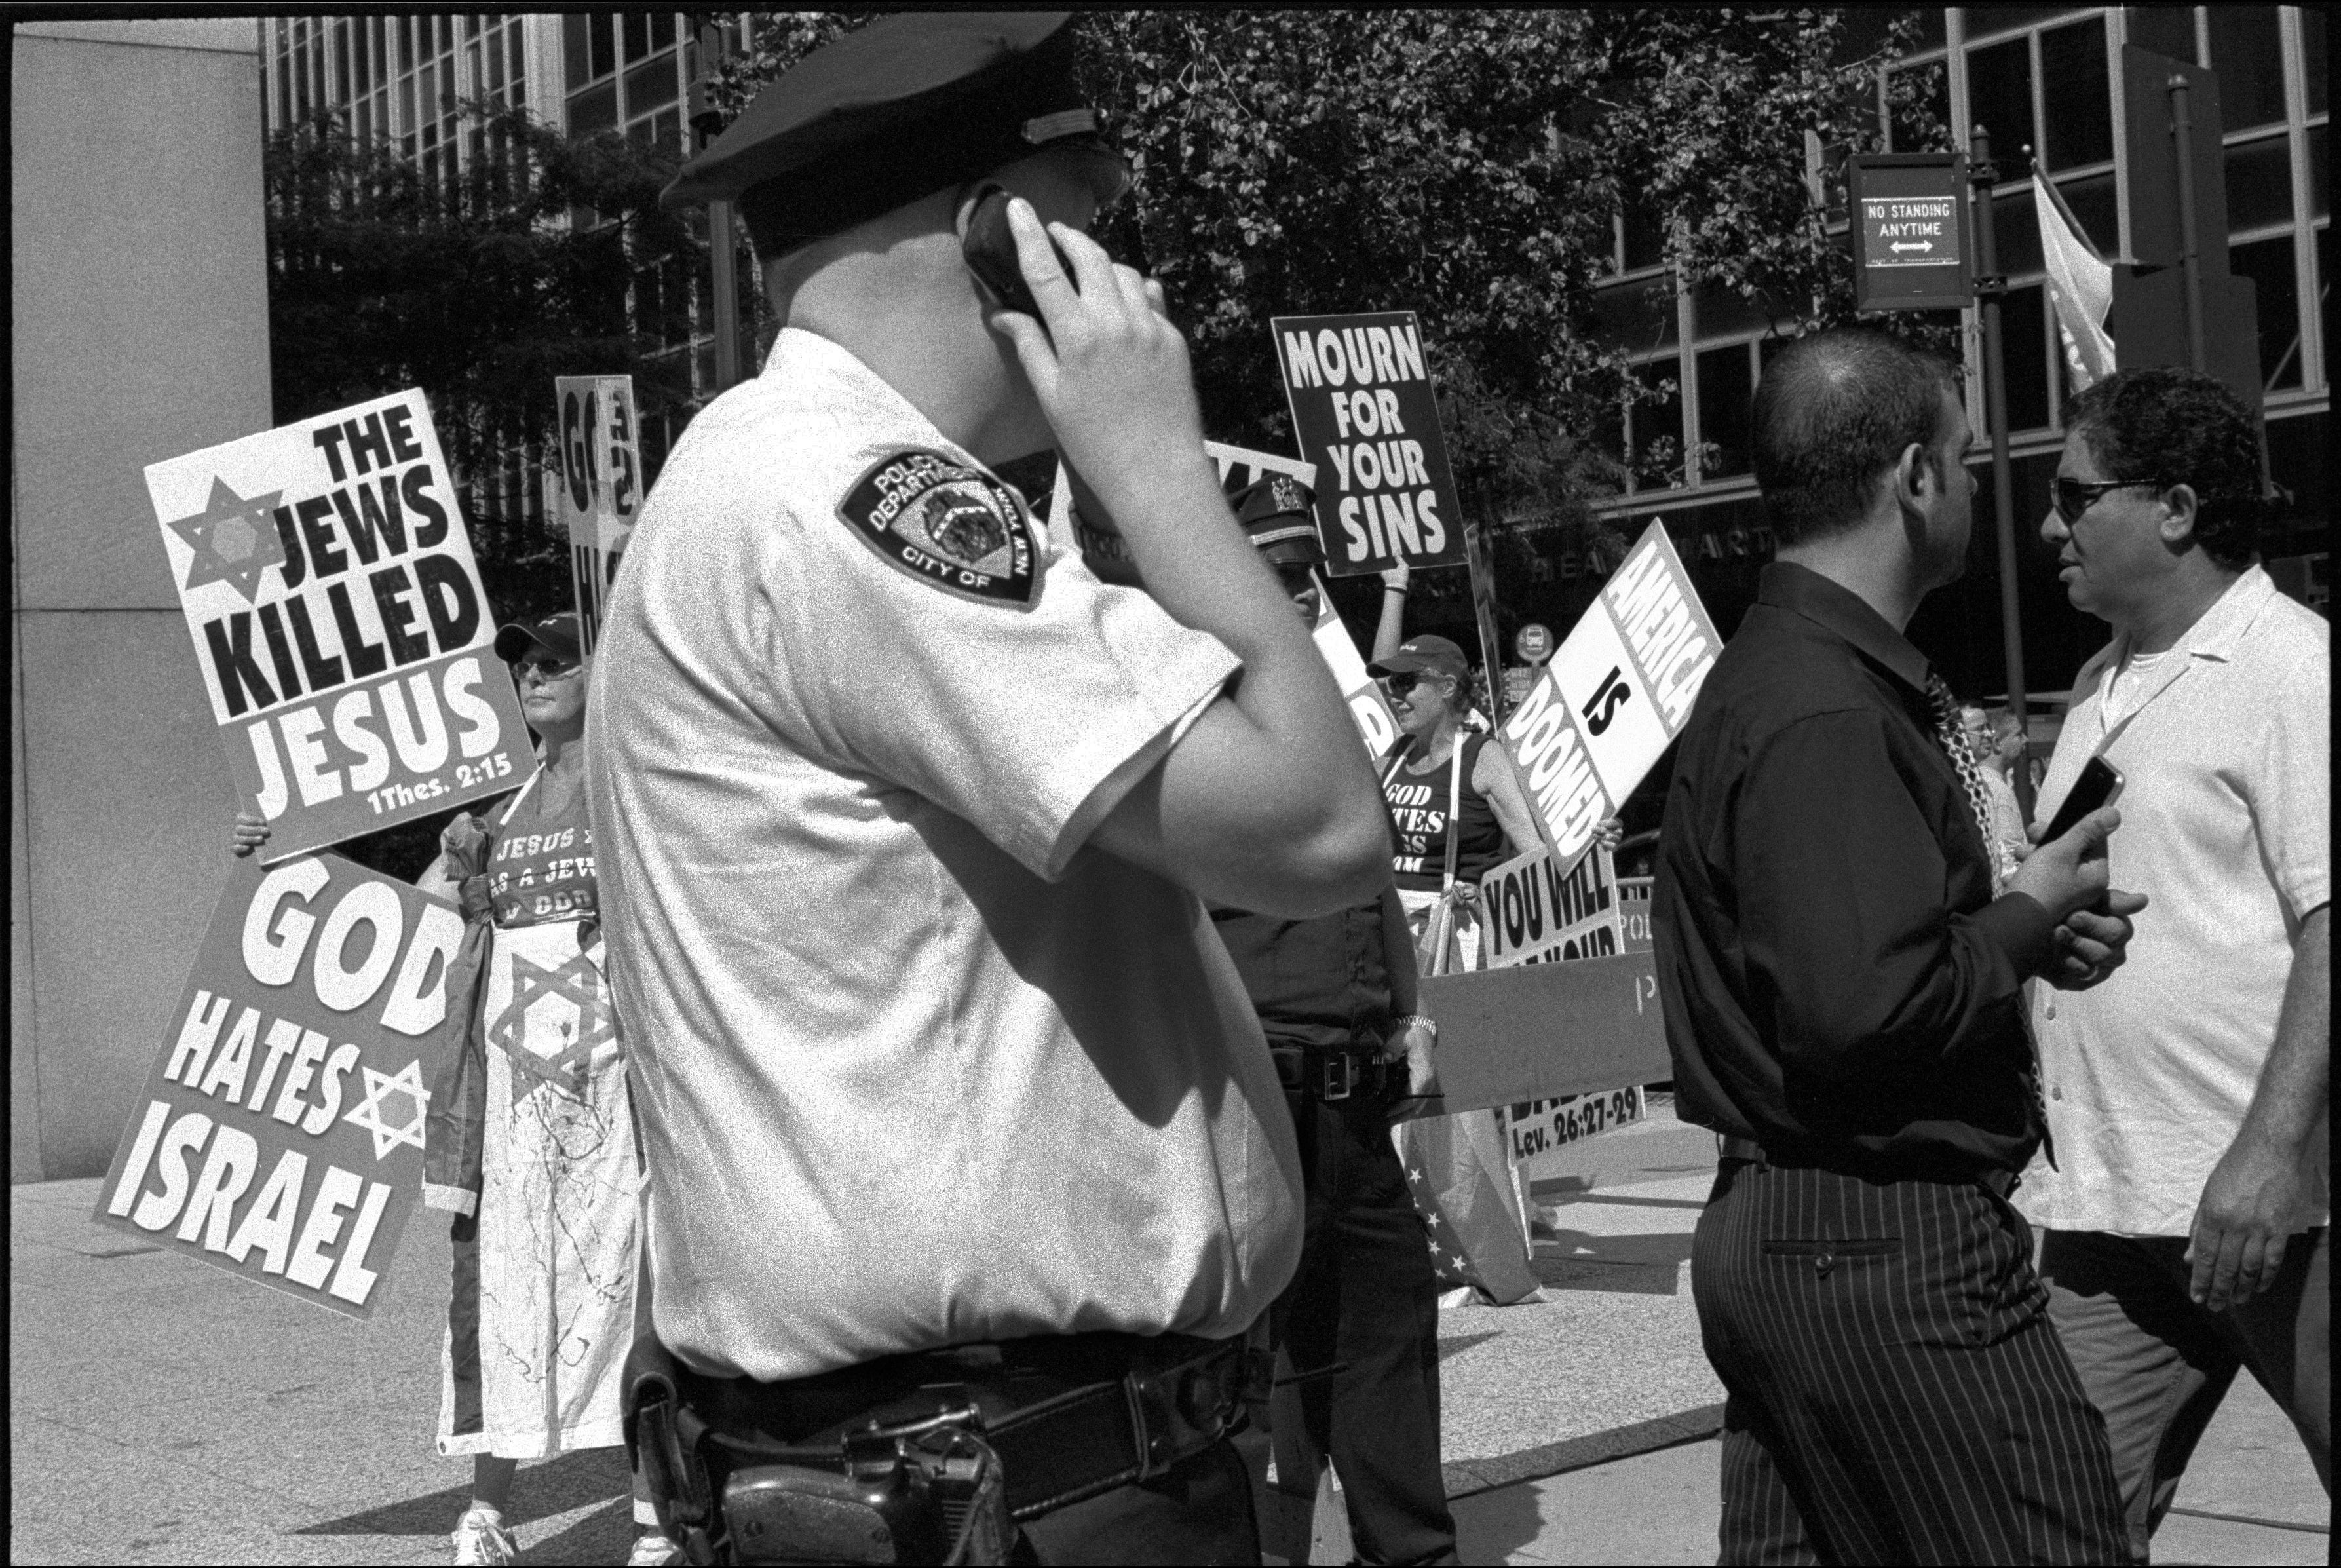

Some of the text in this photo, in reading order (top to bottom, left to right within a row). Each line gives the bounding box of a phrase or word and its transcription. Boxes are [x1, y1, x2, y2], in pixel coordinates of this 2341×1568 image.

[1868, 204, 1950, 218] NO STANDING
[1879, 222, 1942, 237] ANYTIME
[1284, 325, 1426, 388] MOURN
[313, 404, 423, 483] THE
[1331, 389, 1405, 438] FOR
[1326, 440, 1430, 491] YOUR
[273, 464, 449, 590] JEWS
[1339, 489, 1445, 562] SINS
[902, 546, 953, 577] CITY
[959, 571, 992, 587] OF
[204, 554, 480, 717] KILLED
[1607, 540, 1715, 728] AMERICA
[1582, 665, 1631, 736] IS
[248, 657, 500, 820] JESUS
[456, 753, 512, 788] 2:15
[1506, 674, 1605, 857] DOOMED
[1386, 784, 1432, 805] GOD
[497, 828, 575, 861] JESUS
[519, 868, 534, 887] A
[1484, 862, 1542, 955] YOU
[1544, 841, 1610, 930] WILL
[242, 857, 465, 1035] GOD
[164, 989, 360, 1135] HATES
[1513, 1127, 1550, 1160] Lev.
[1554, 1086, 1637, 1145] 26:27-29
[107, 1100, 392, 1305] ISRAEL
